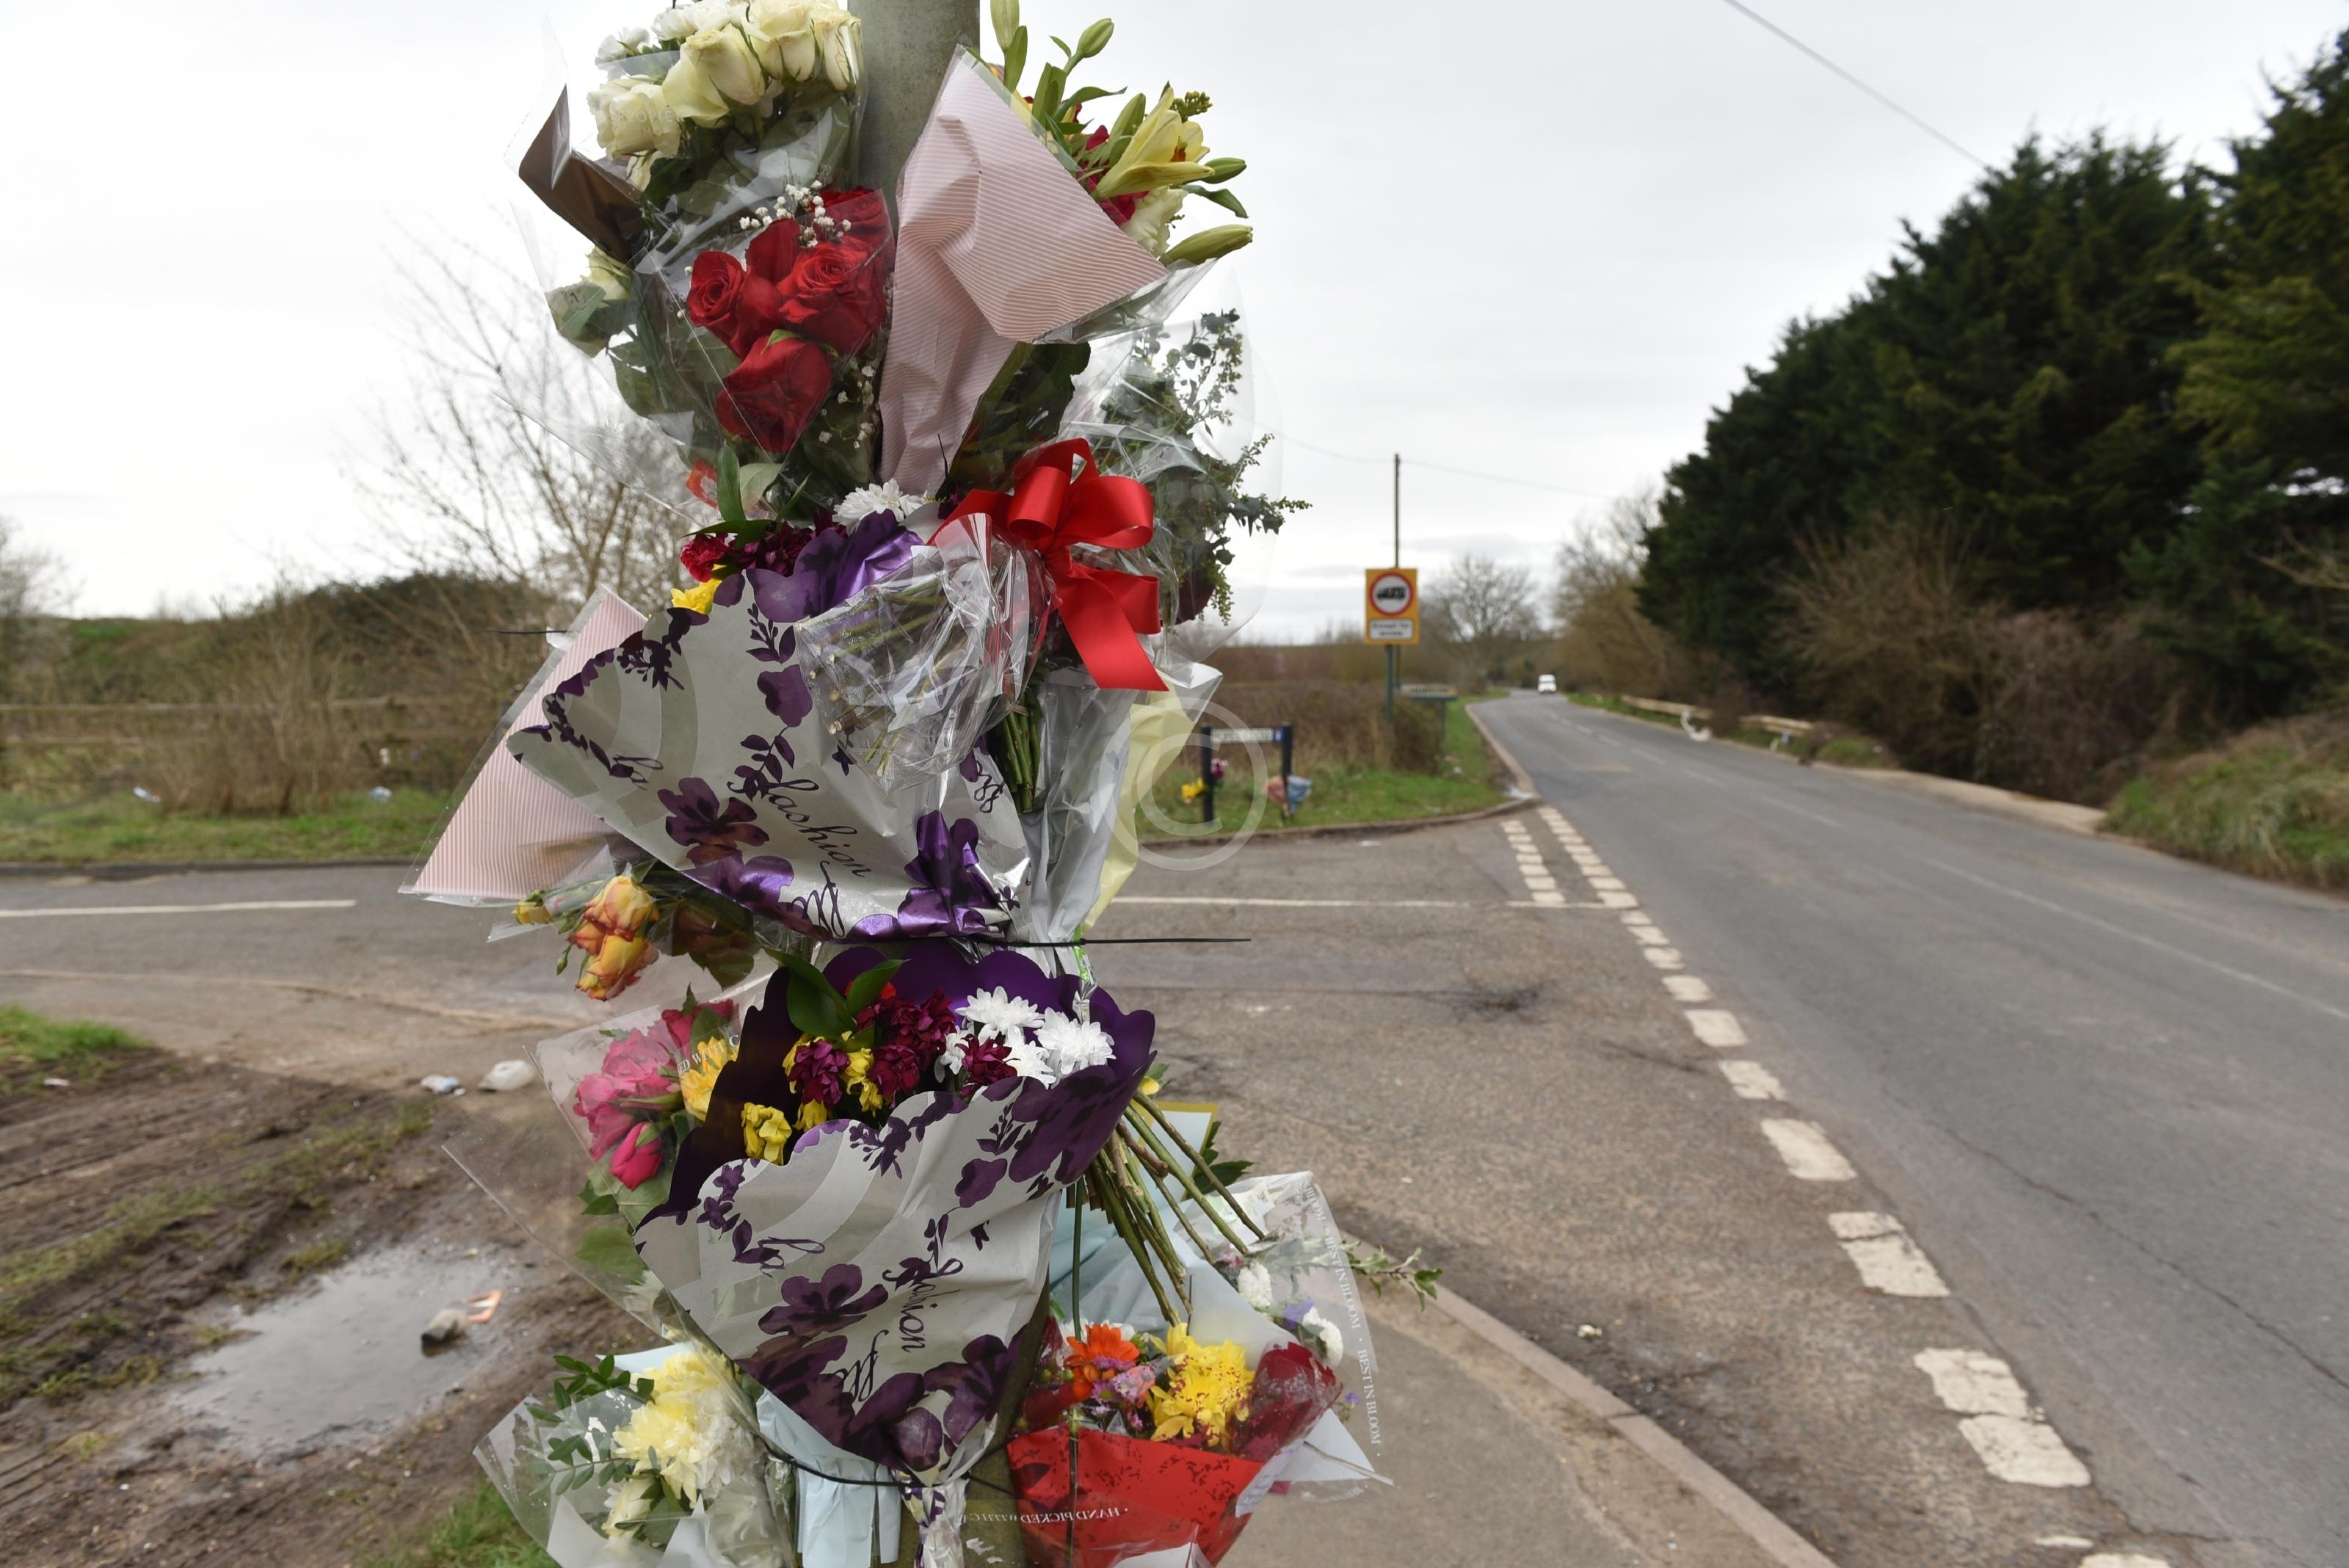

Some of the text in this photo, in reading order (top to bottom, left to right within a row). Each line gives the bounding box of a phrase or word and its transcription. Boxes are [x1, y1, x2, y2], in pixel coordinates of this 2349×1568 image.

[1340, 1284, 1361, 1329] BLOOM
[1358, 1349, 1382, 1445] BEST IN BLOOM
